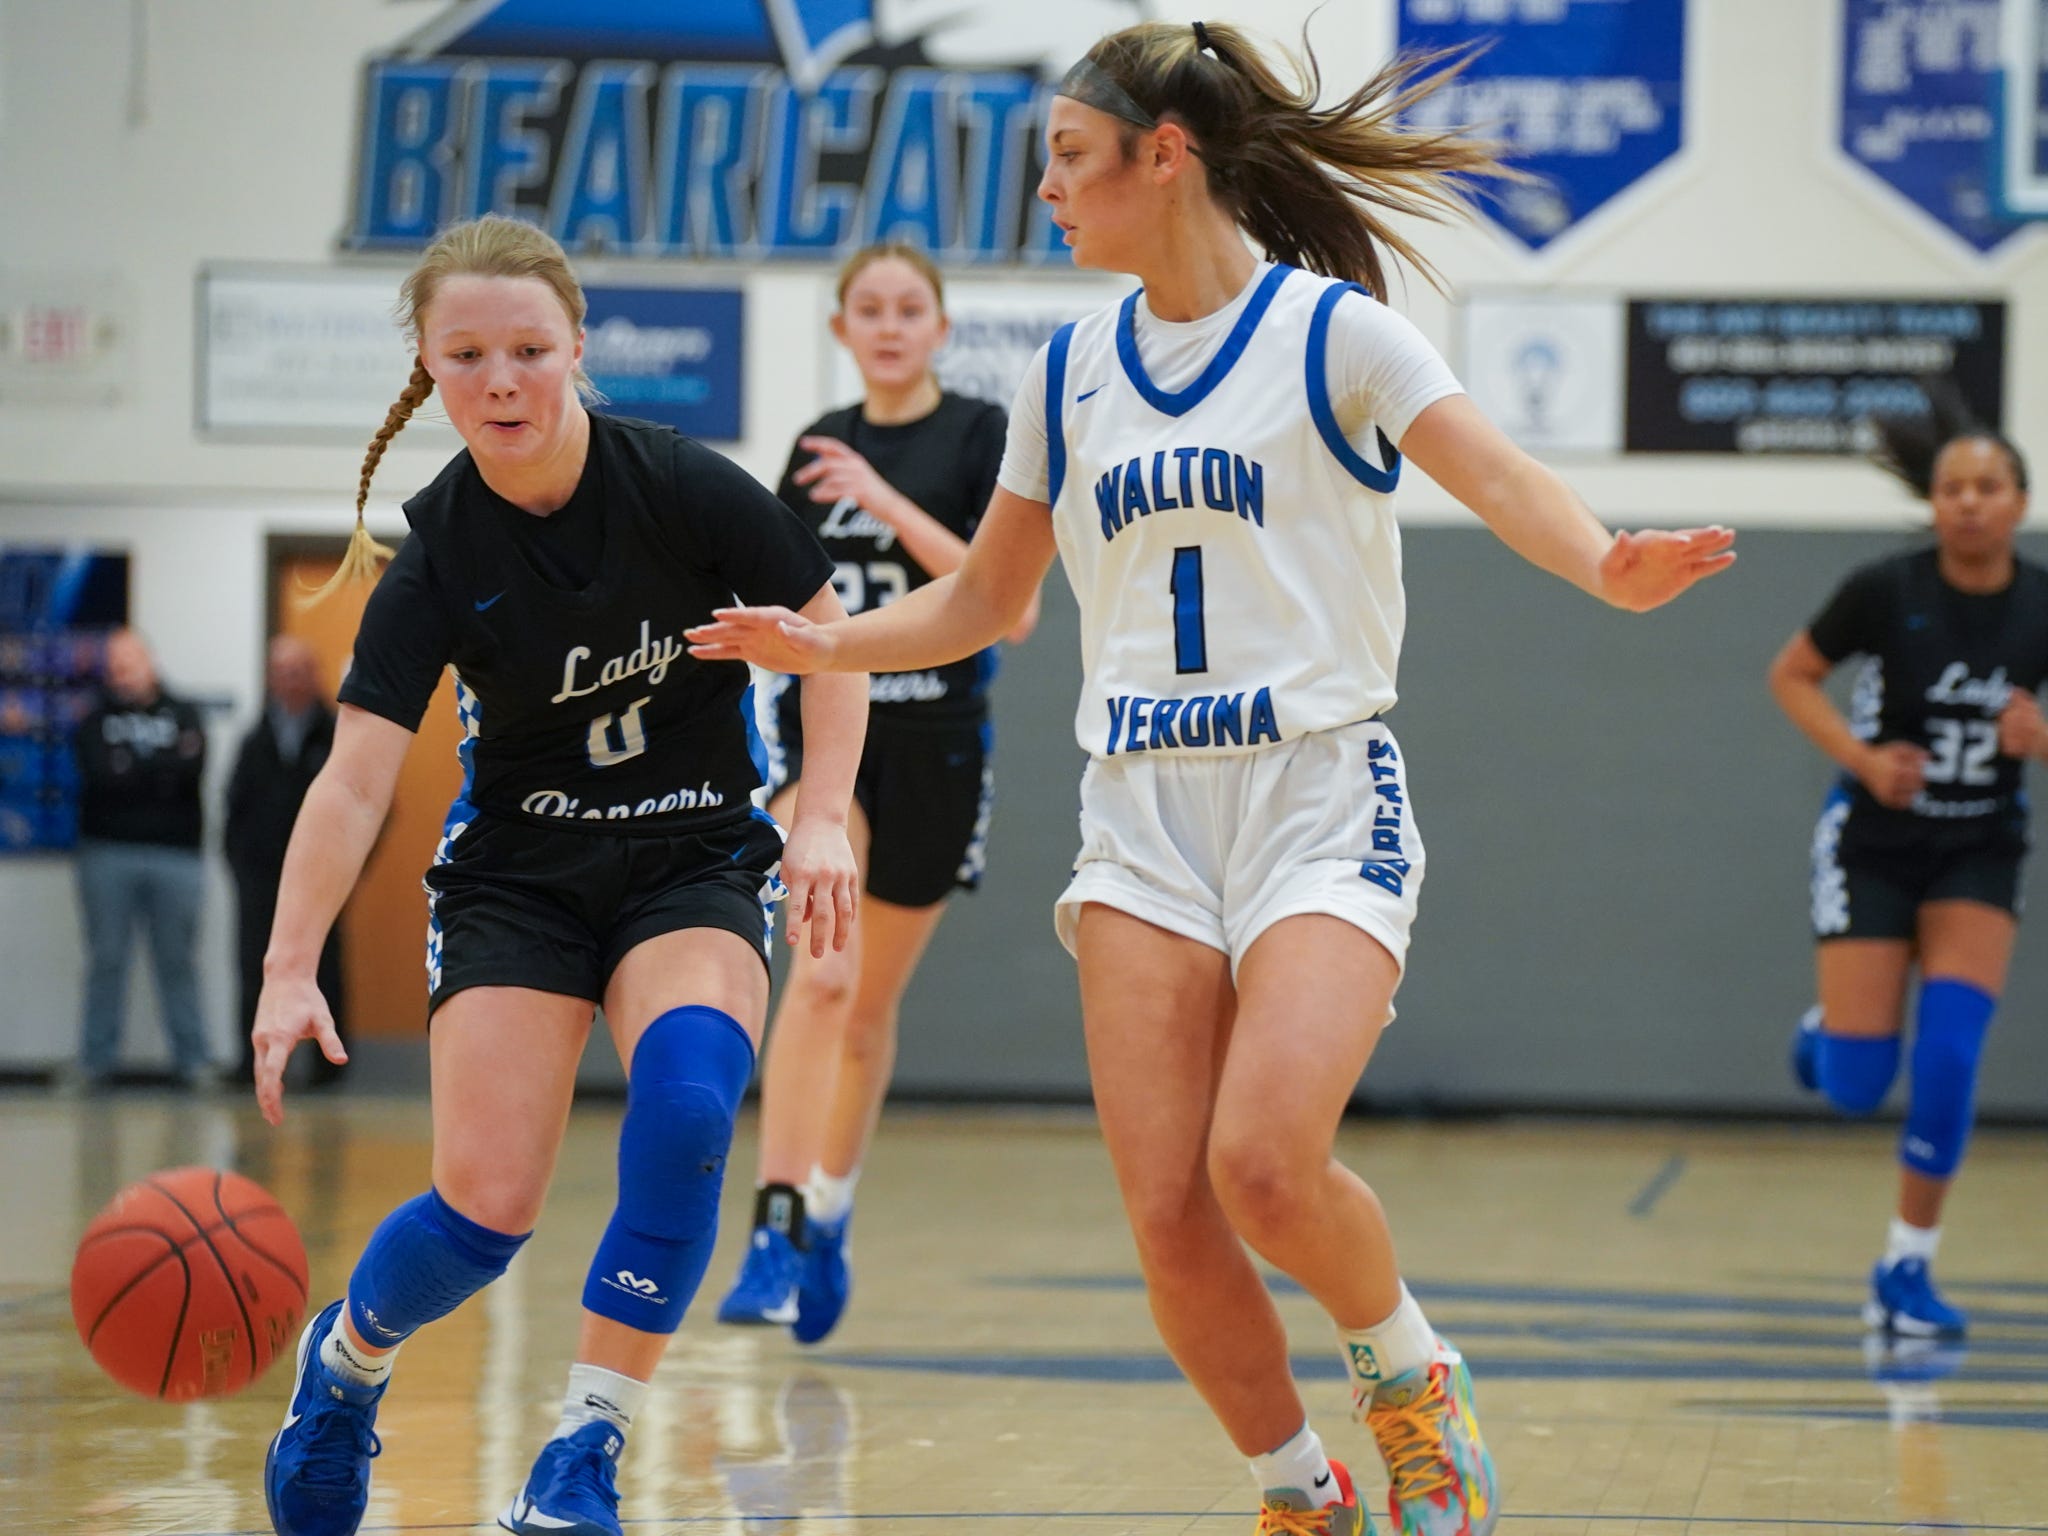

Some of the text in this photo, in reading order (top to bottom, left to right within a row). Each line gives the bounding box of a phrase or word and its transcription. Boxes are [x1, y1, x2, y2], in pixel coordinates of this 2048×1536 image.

[352, 58, 1074, 258] BEARCAT
[1094, 446, 1265, 542] WALTON
[1170, 545, 1208, 674] 1
[551, 619, 683, 704] Lady
[1106, 686, 1282, 755] VERONA
[1923, 716, 1999, 786] 32
